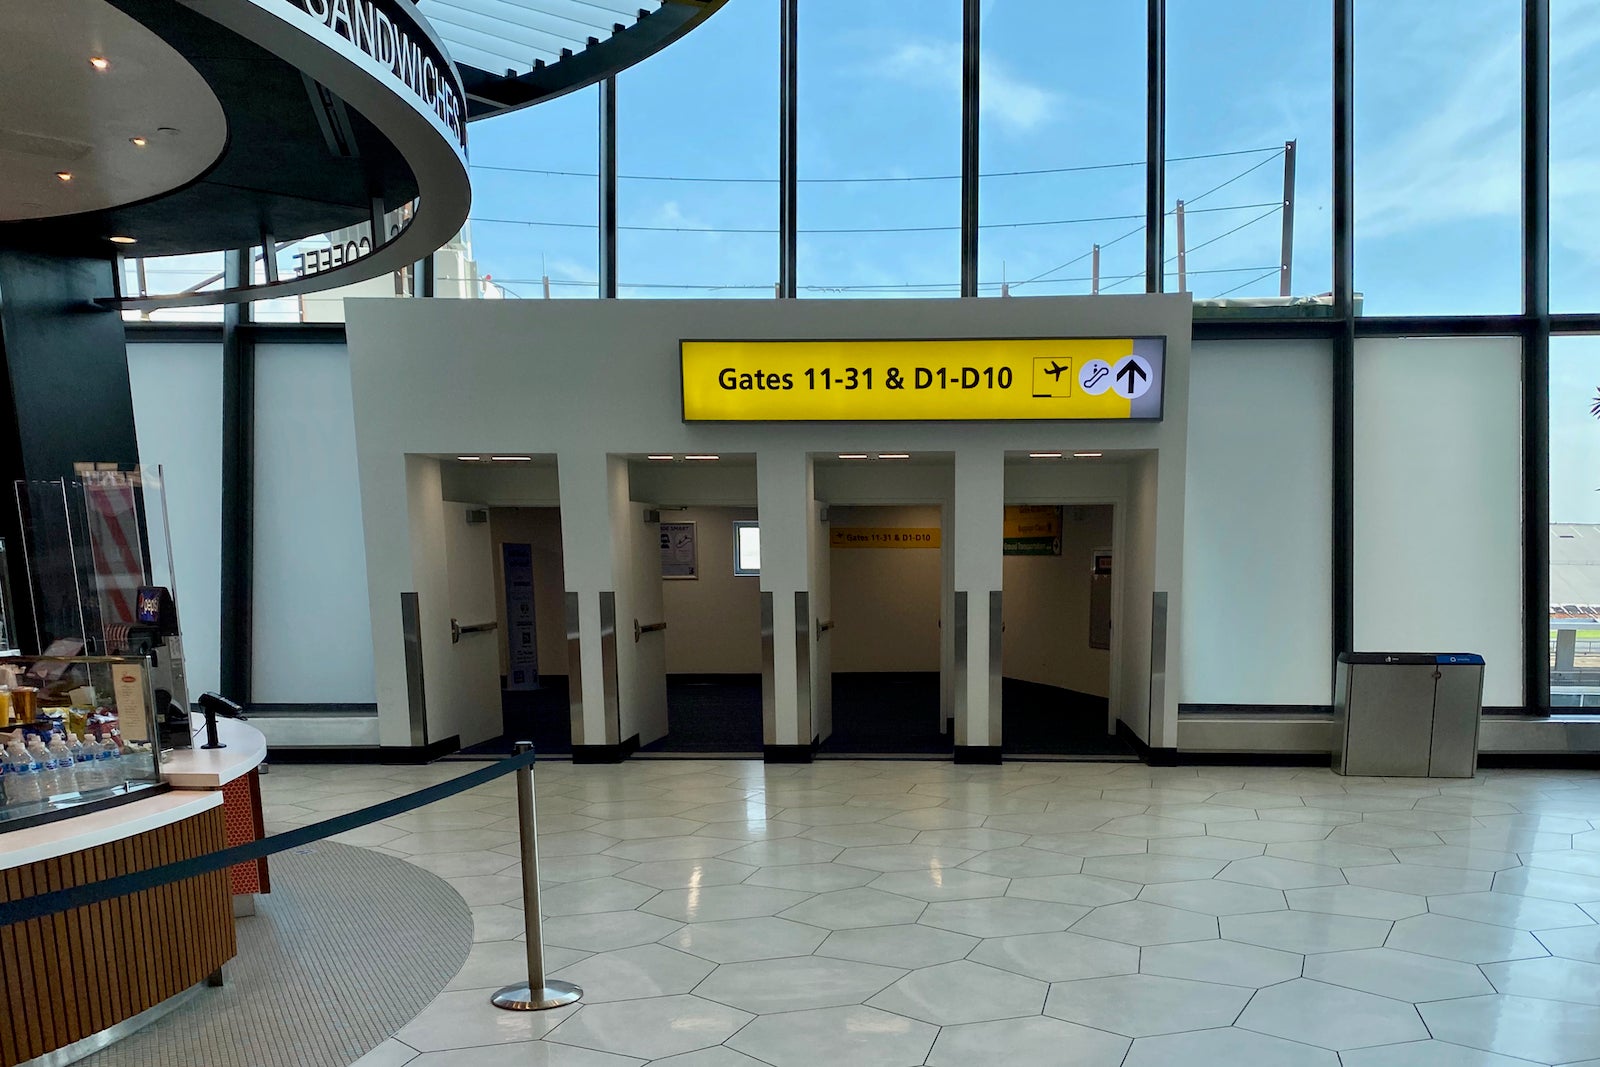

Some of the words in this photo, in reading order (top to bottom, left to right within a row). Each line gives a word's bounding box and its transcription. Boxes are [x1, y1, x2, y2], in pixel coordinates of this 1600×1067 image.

[718, 367, 794, 391] Gates
[804, 367, 873, 390] 11-31
[885, 367, 905, 390] &
[914, 366, 1013, 390] D1-D10
[846, 534, 869, 542] Gates
[871, 534, 892, 542] 11-31
[902, 533, 931, 541] D1-D10
